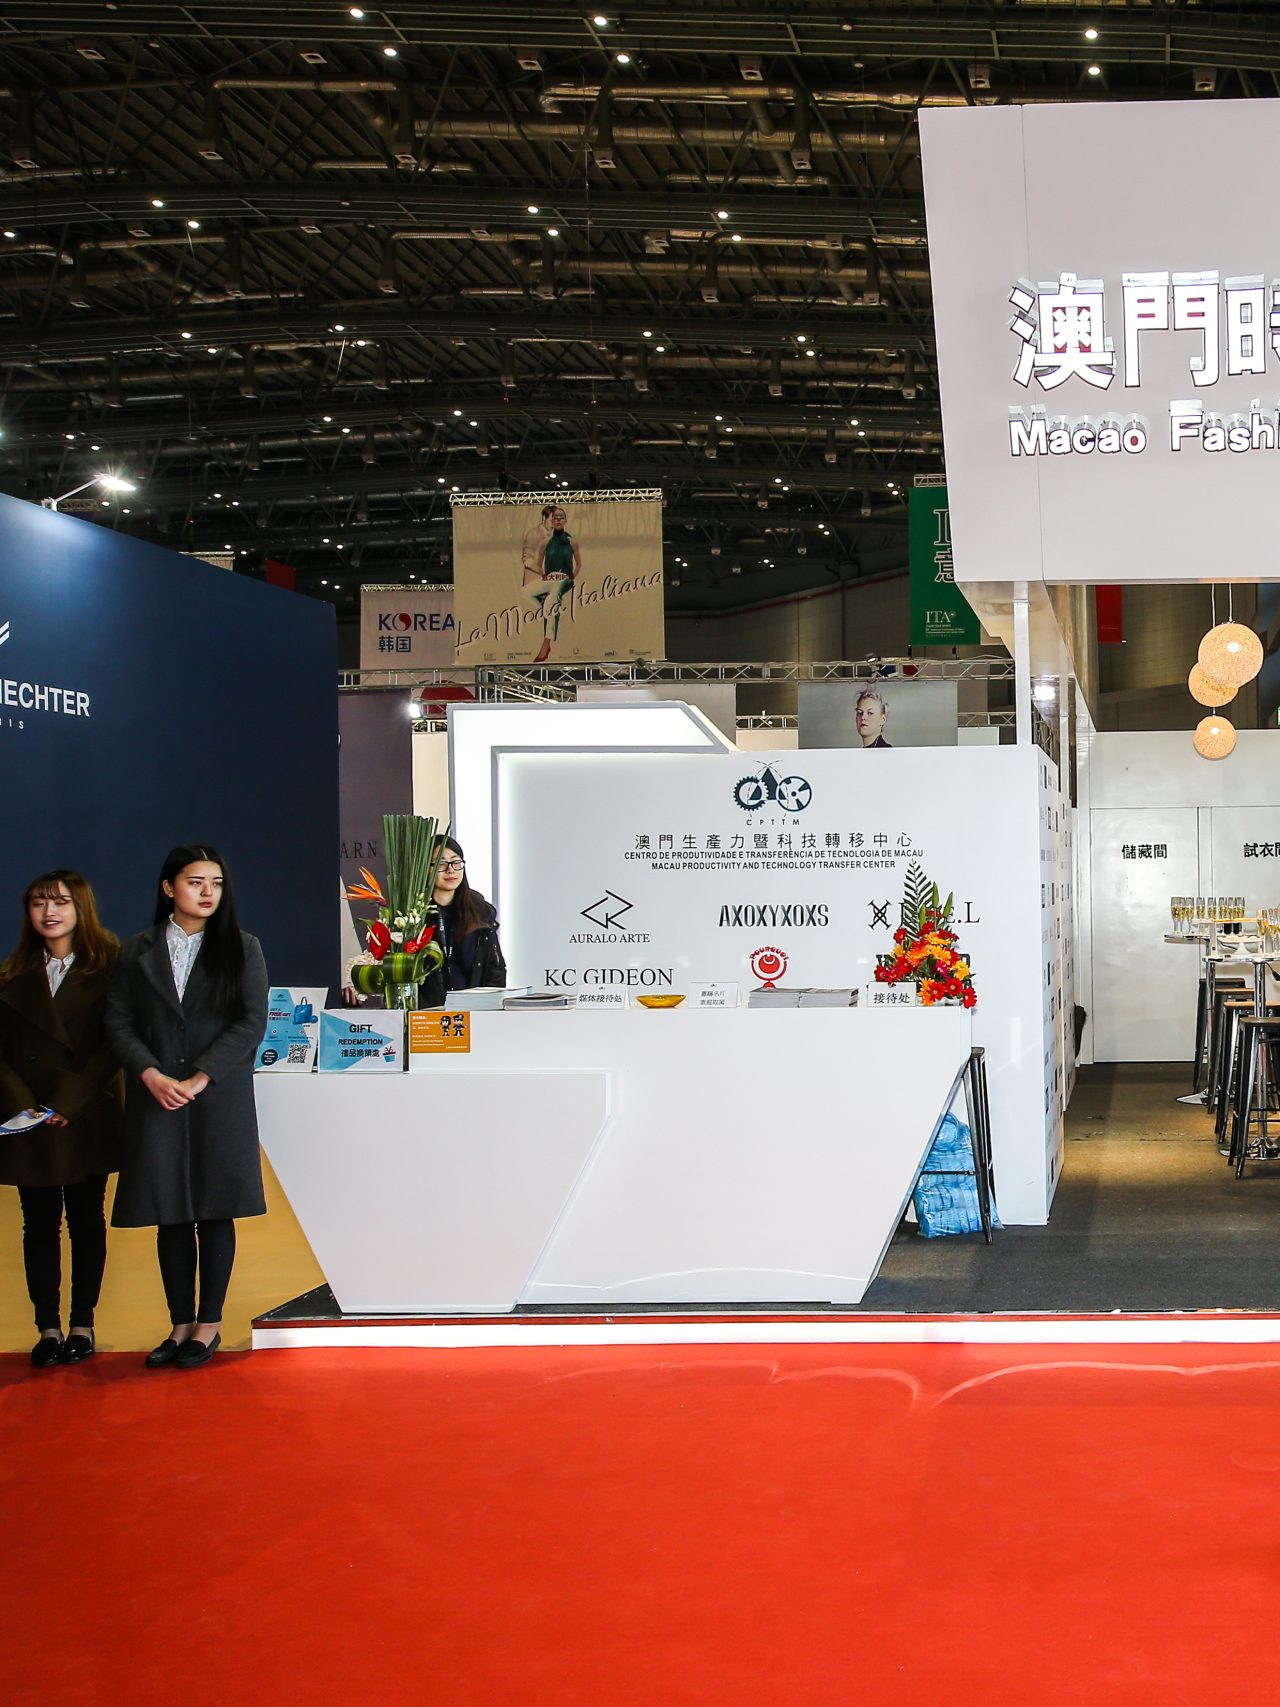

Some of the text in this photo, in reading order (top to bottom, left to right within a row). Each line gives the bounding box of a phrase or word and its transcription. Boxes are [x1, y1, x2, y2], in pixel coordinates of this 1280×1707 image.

[1009, 415, 1148, 457] Macao
[571, 571, 662, 622] Italiana
[378, 612, 455, 631] KOREA
[378, 635, 412, 653] 韩国
[0, 678, 90, 717] ECHTER
[746, 818, 800, 826] CPTTM
[635, 831, 913, 850] 澳門生產力暨科技轉移中心
[624, 849, 924, 860] CENTRO DE PRODUTIVIDADE E TRANSFERÊNCIA DE TECNOLOGIA DE MACAU
[1121, 843, 1168, 859] 儲藏間
[651, 860, 896, 870] MACAU PRODUCTIVITY AND TECHNOLOGY TRANSFER CENTER
[718, 904, 830, 927] AXOXYXOXS
[569, 933, 651, 944] AURALO ARTE
[749, 945, 790, 960] POURQUOI
[544, 968, 674, 986] KC GIDEON
[579, 994, 622, 1003] 媒体接待处
[873, 992, 910, 1004] 接待处
[349, 1024, 373, 1033] GIFT
